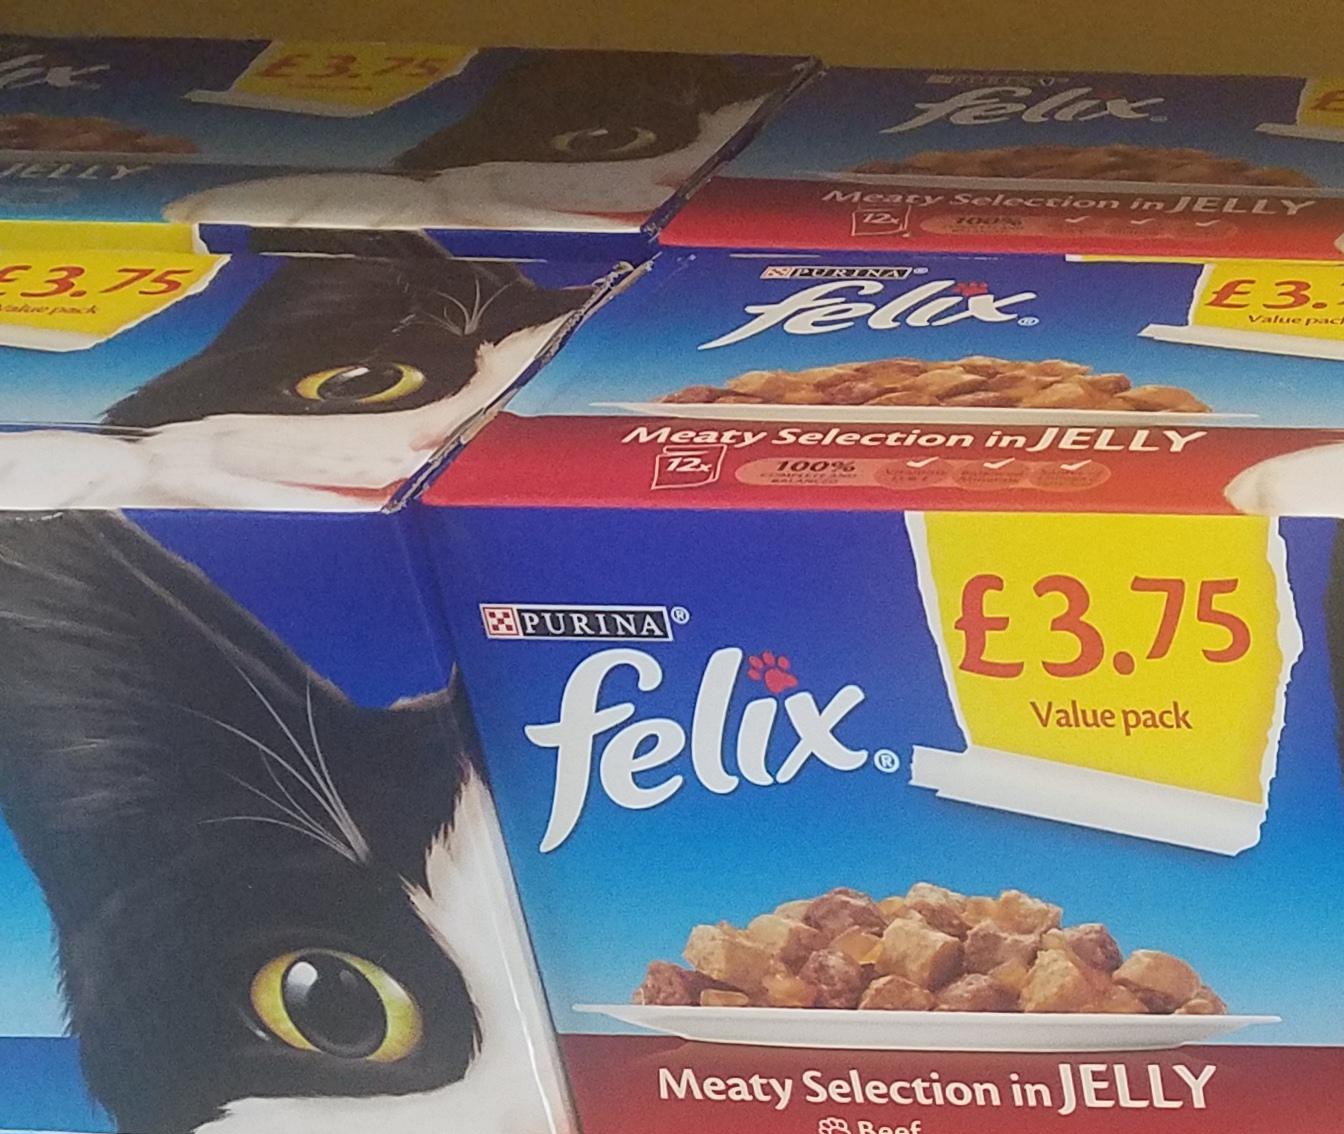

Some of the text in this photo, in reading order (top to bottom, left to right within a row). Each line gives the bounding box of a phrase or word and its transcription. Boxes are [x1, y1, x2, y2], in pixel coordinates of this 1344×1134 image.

[256, 54, 449, 78] £3.75
[880, 87, 1164, 134] felix
[823, 190, 1317, 216] Meaty Selection in JELLY
[697, 280, 1037, 350] felix
[1248, 313, 1300, 327] Value
[621, 426, 1208, 453] Meaty Selection in JELLY
[666, 456, 712, 472] 12x
[775, 460, 857, 472] 100%
[524, 612, 664, 638] PURINA
[954, 574, 1251, 678] £3.75
[1030, 701, 1192, 736] Value pack
[525, 648, 868, 854] felix
[658, 1063, 1217, 1114] Meaty Selection in JELLY
